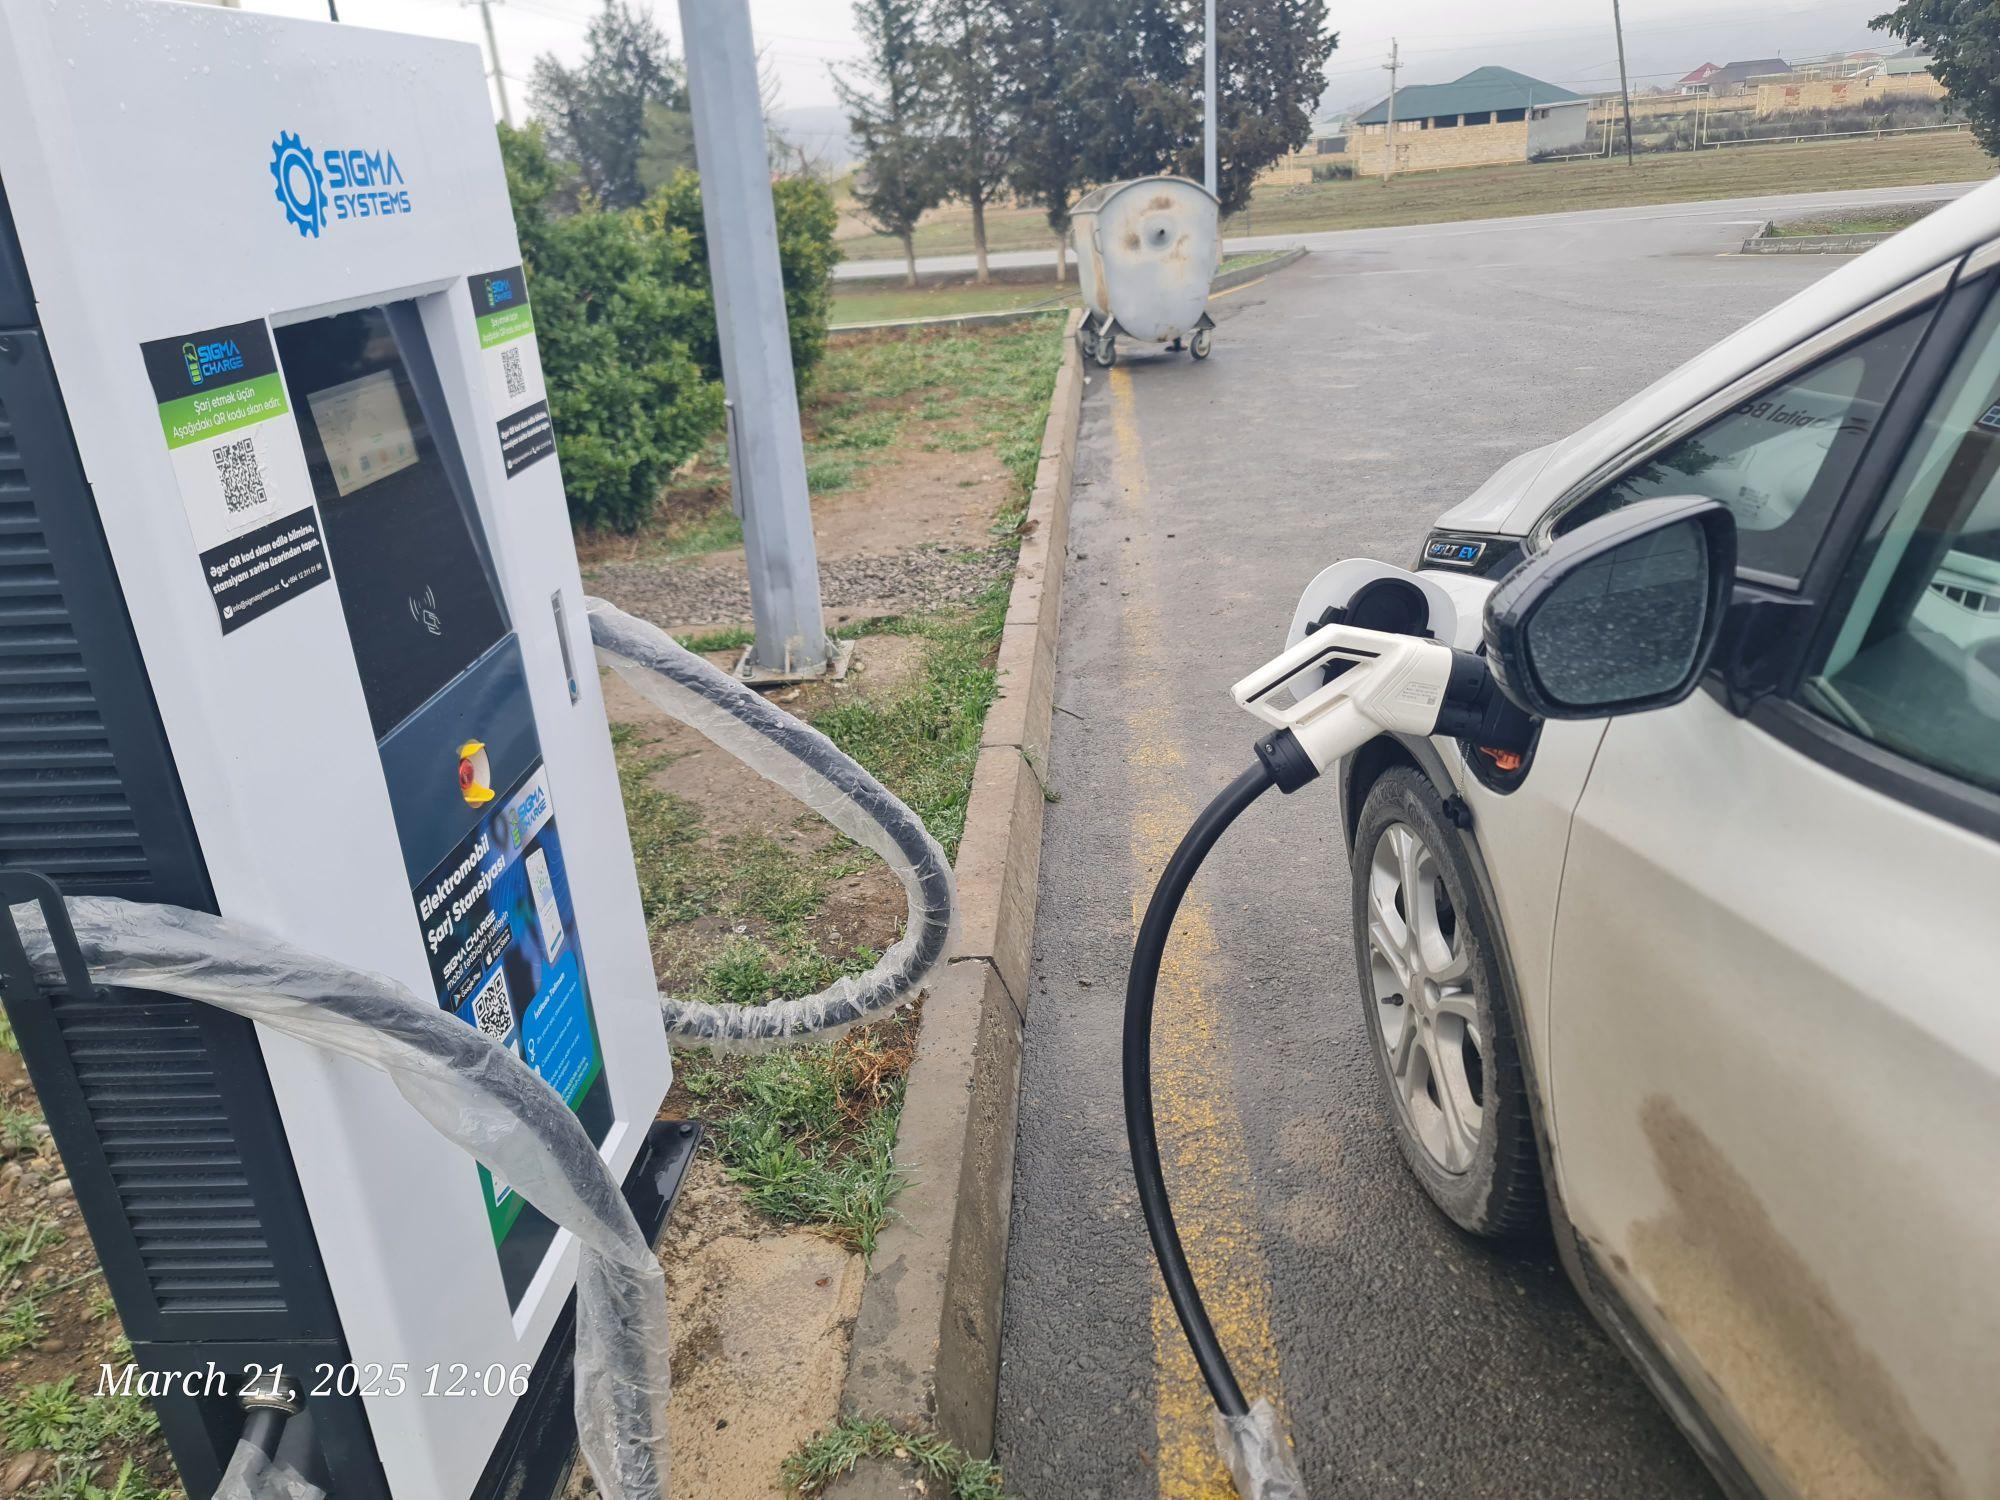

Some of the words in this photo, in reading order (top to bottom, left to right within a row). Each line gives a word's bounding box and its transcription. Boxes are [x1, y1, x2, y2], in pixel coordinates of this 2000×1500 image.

[324, 149, 404, 188] SIGMA
[334, 191, 411, 219] SYSTEMS
[197, 340, 240, 363] SIGMA
[202, 356, 244, 376] CHARGE
[193, 398, 212, 415] Şarj
[237, 387, 255, 403] üçün
[213, 412, 227, 425] QR
[227, 407, 247, 421] kodu
[229, 555, 241, 568] QR
[241, 549, 255, 564] kod
[255, 544, 272, 557] skan
[1458, 546, 1478, 559] EV
[517, 784, 545, 818] SIGMA
[419, 833, 490, 922] Elektromobil
[428, 911, 454, 954] Şarj
[452, 854, 506, 922] Stansiyası
[443, 947, 467, 980] SIGMA
[465, 909, 496, 952] CHARGE
[446, 964, 464, 991] mobil
